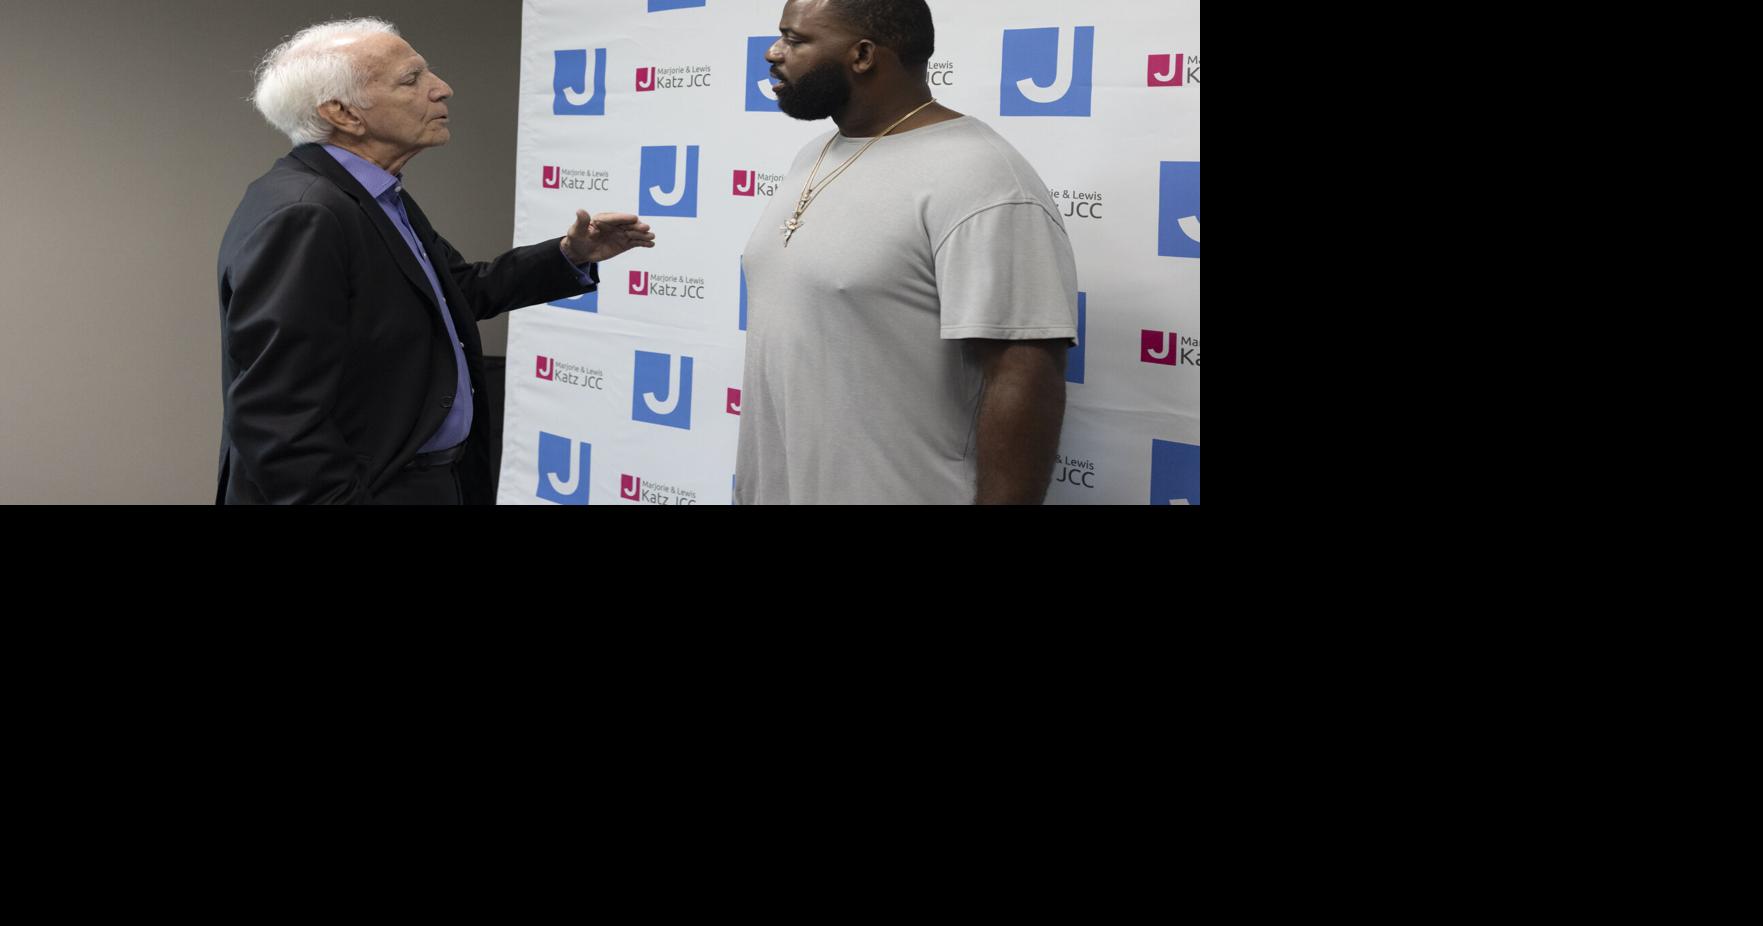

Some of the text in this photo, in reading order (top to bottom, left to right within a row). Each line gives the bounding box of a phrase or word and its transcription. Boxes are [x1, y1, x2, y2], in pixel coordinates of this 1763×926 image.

[657, 66, 684, 76] Marjorie
[692, 65, 711, 73] Lewis
[928, 60, 954, 70] Lewis
[657, 74, 712, 88] Katz JCC
[561, 176, 608, 190] Katz JCC
[757, 173, 784, 182] Marjori
[757, 182, 778, 196] Ka
[1062, 190, 1070, 198] &
[1072, 190, 1102, 200] Lewis
[1064, 202, 1102, 218] JCC
[650, 274, 678, 282] Marjorie
[686, 276, 704, 284] Lewis
[650, 283, 704, 299] Katz JCC
[555, 370, 603, 390] Katz JCC
[1065, 456, 1094, 470] Lewis
[1056, 467, 1095, 488] JCC
[642, 490, 669, 505] Katz
[677, 488, 696, 498] Lewis
